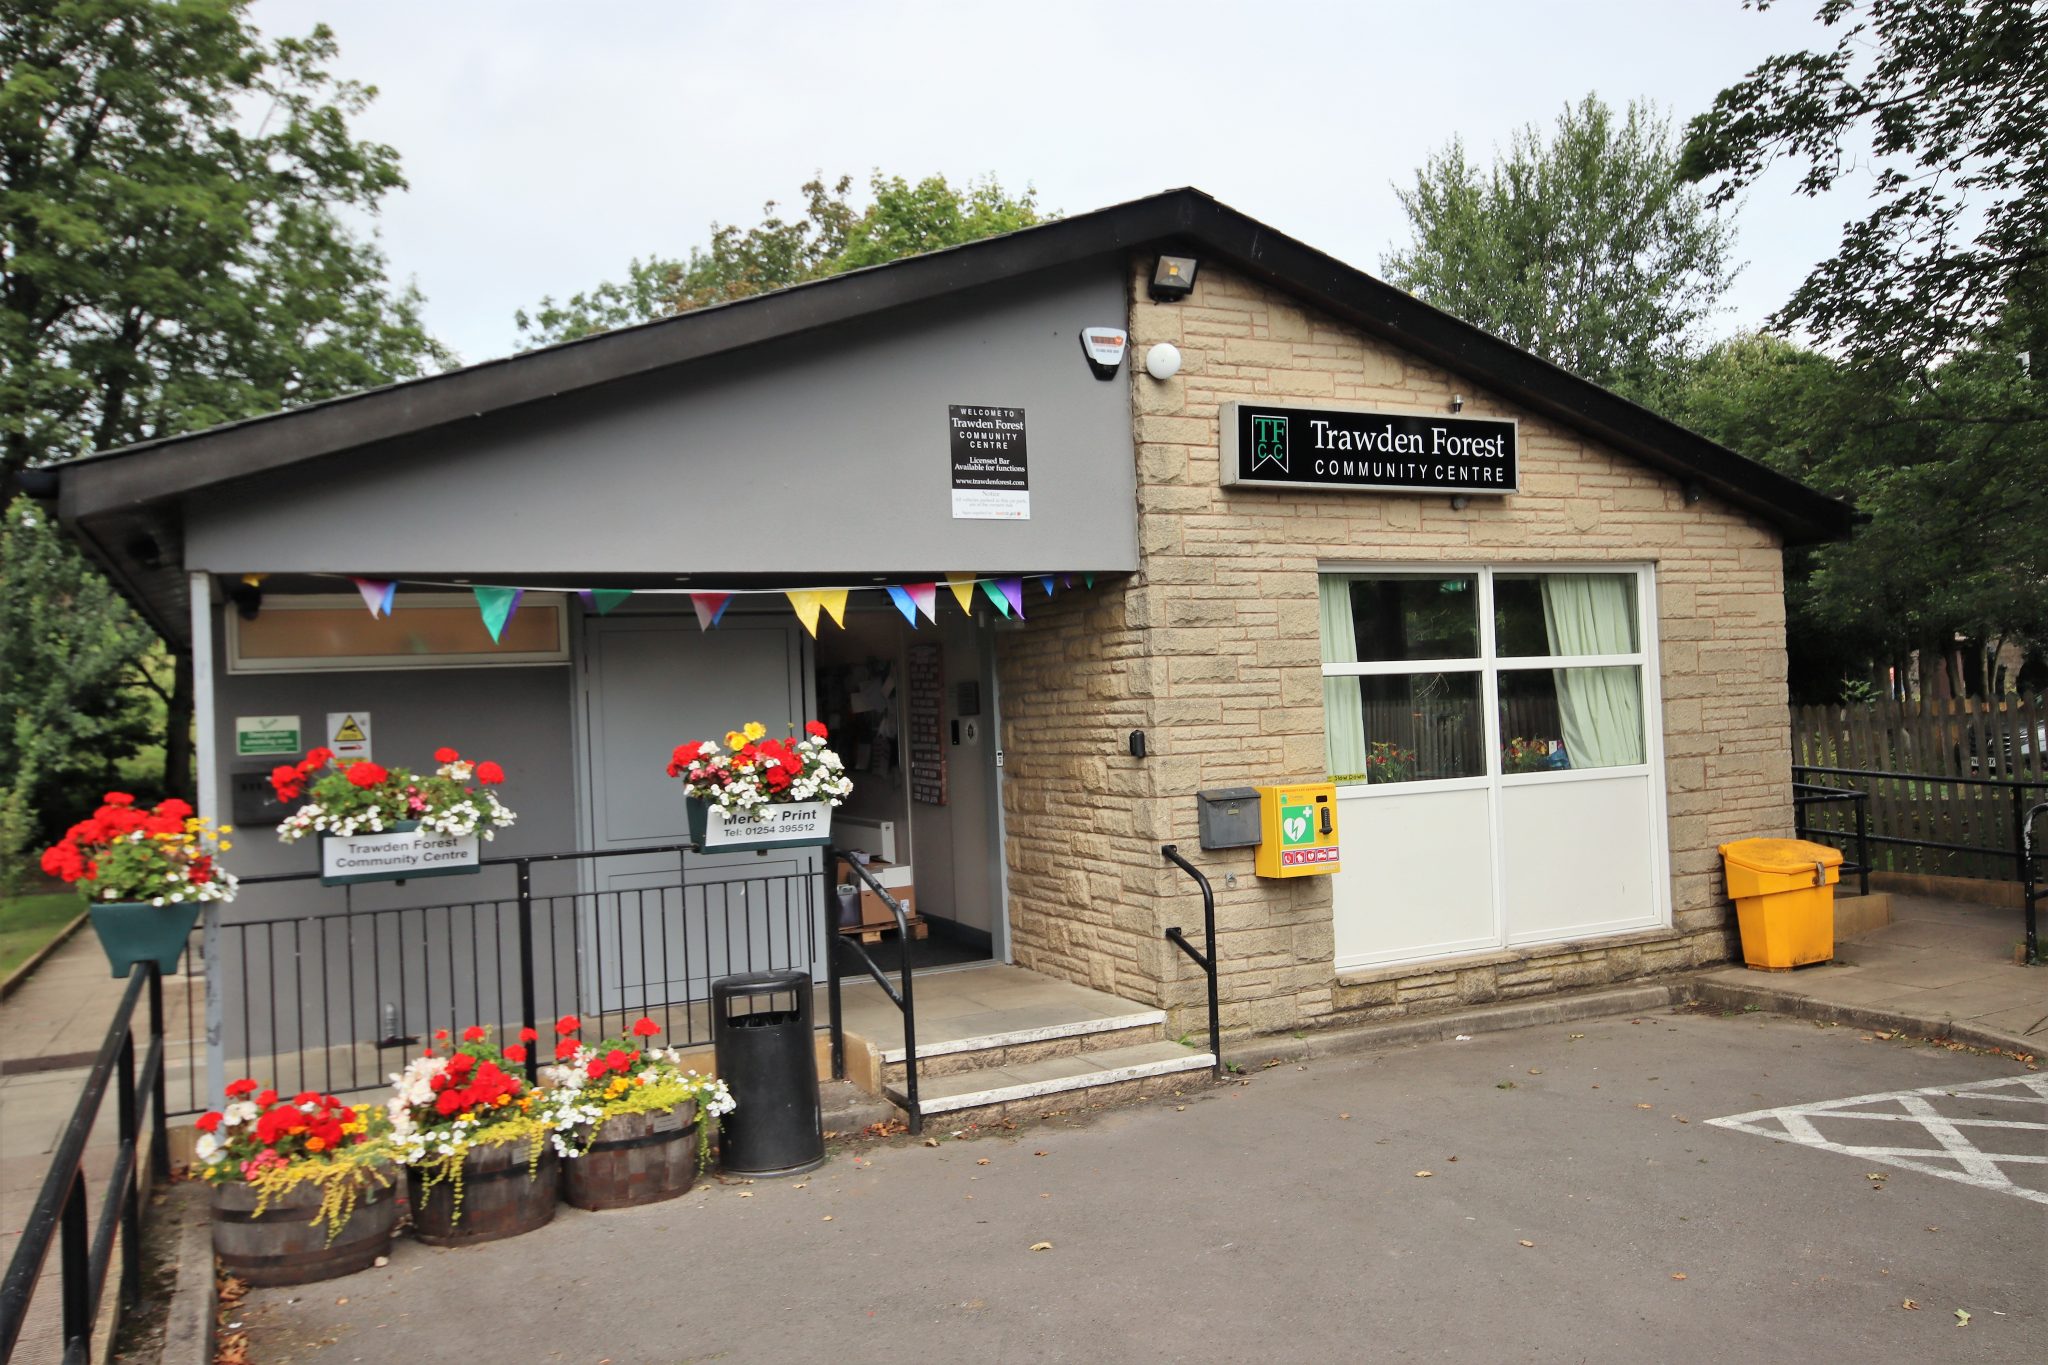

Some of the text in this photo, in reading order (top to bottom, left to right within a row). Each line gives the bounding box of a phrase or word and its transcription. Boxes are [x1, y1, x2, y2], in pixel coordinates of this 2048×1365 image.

[952, 417, 1024, 431] Trawden Forest
[1255, 418, 1286, 443] TF
[960, 431, 1017, 440] COMMUNITY
[1310, 420, 1505, 457] Trawden Forest
[970, 441, 1008, 449] CENTRE
[985, 464, 996, 472] for
[996, 464, 1026, 472] functions
[1315, 459, 1504, 482] COMMUNITY CENTRE
[782, 809, 817, 821] Print
[724, 823, 815, 837] Tel: 01254 395512
[348, 837, 458, 854] Trawden Forest
[335, 849, 468, 869] Community Centre
